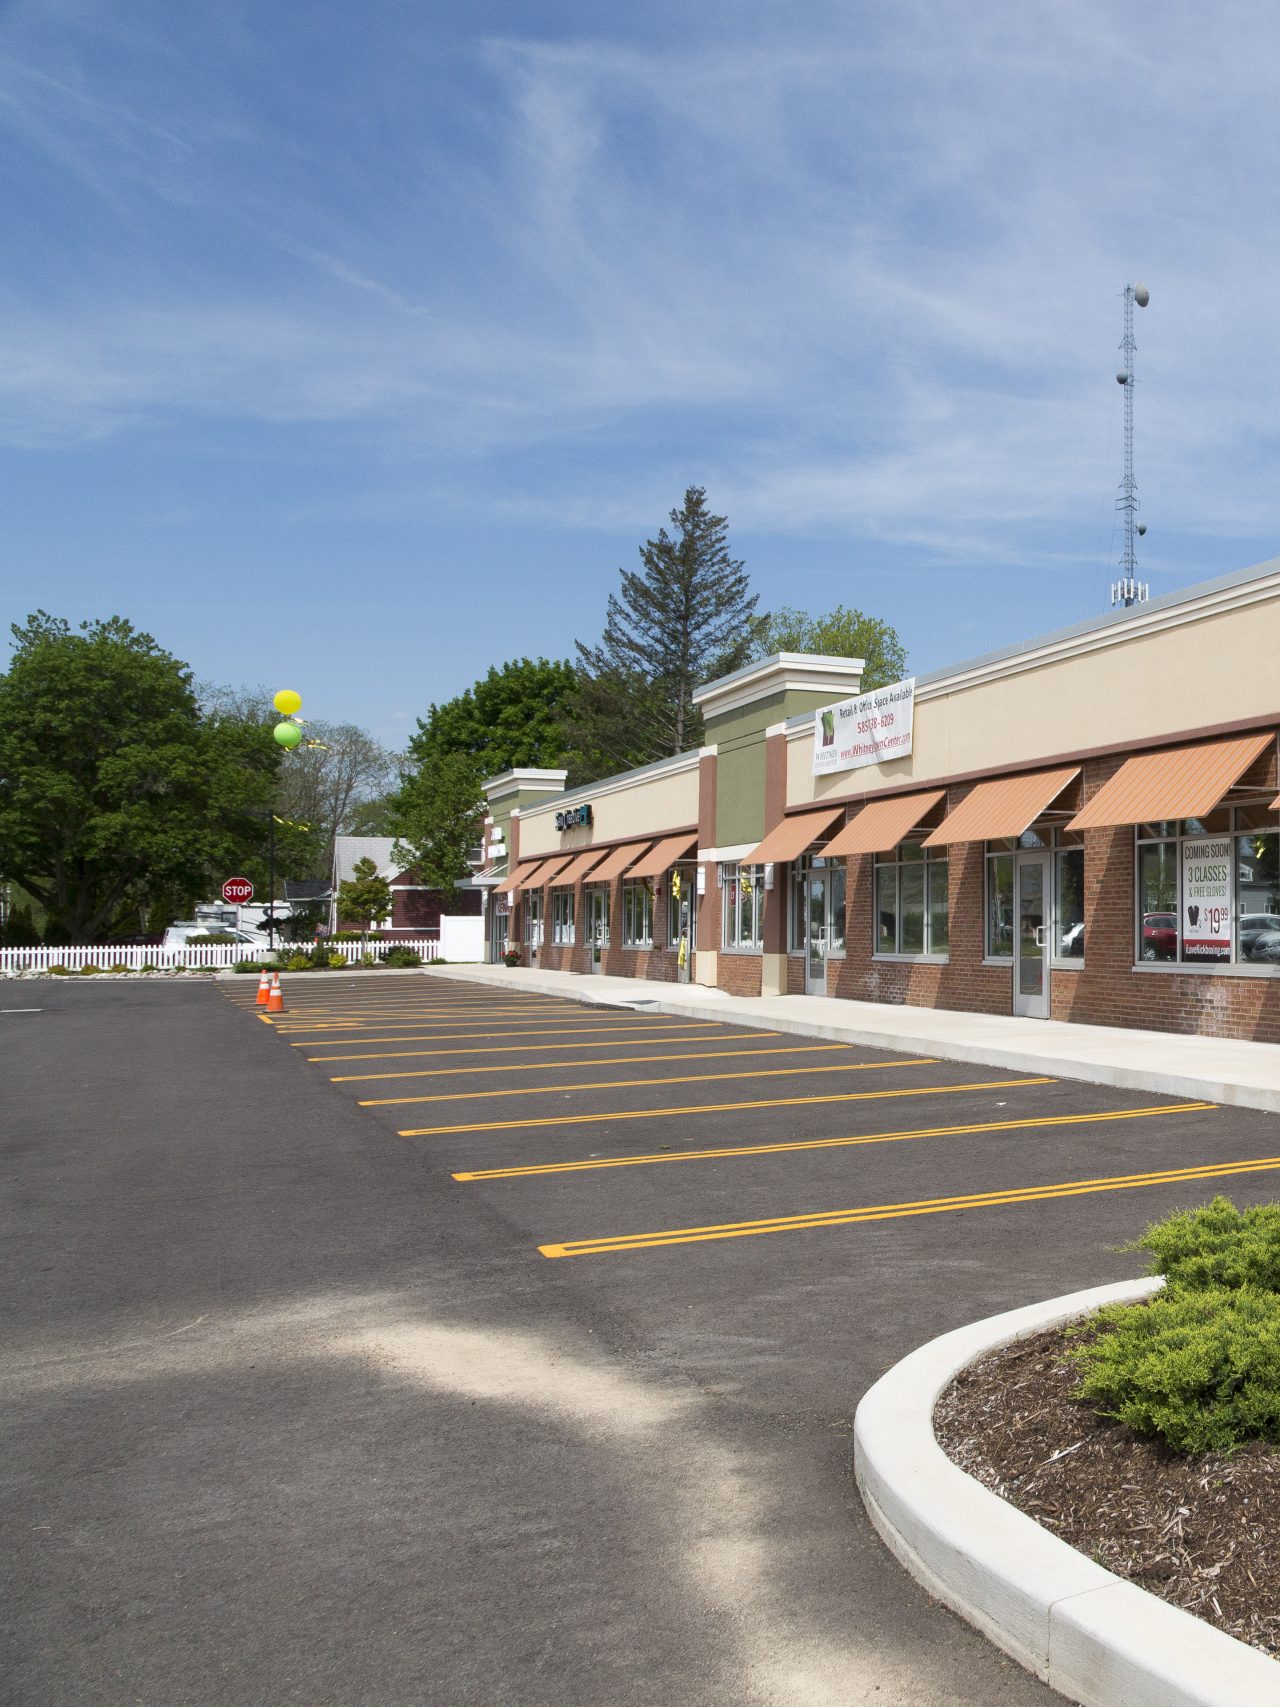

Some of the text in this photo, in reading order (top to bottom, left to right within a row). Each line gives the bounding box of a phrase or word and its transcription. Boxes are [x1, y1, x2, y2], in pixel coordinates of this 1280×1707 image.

[839, 704, 854, 719] Retail
[859, 699, 873, 713] Office
[873, 696, 889, 711] Space
[889, 686, 913, 703] Available
[1185, 845, 1210, 860] COMING
[1188, 864, 1227, 883] 3 CLASSES
[225, 885, 251, 896] STOP
[1194, 886, 1205, 898] FREE
